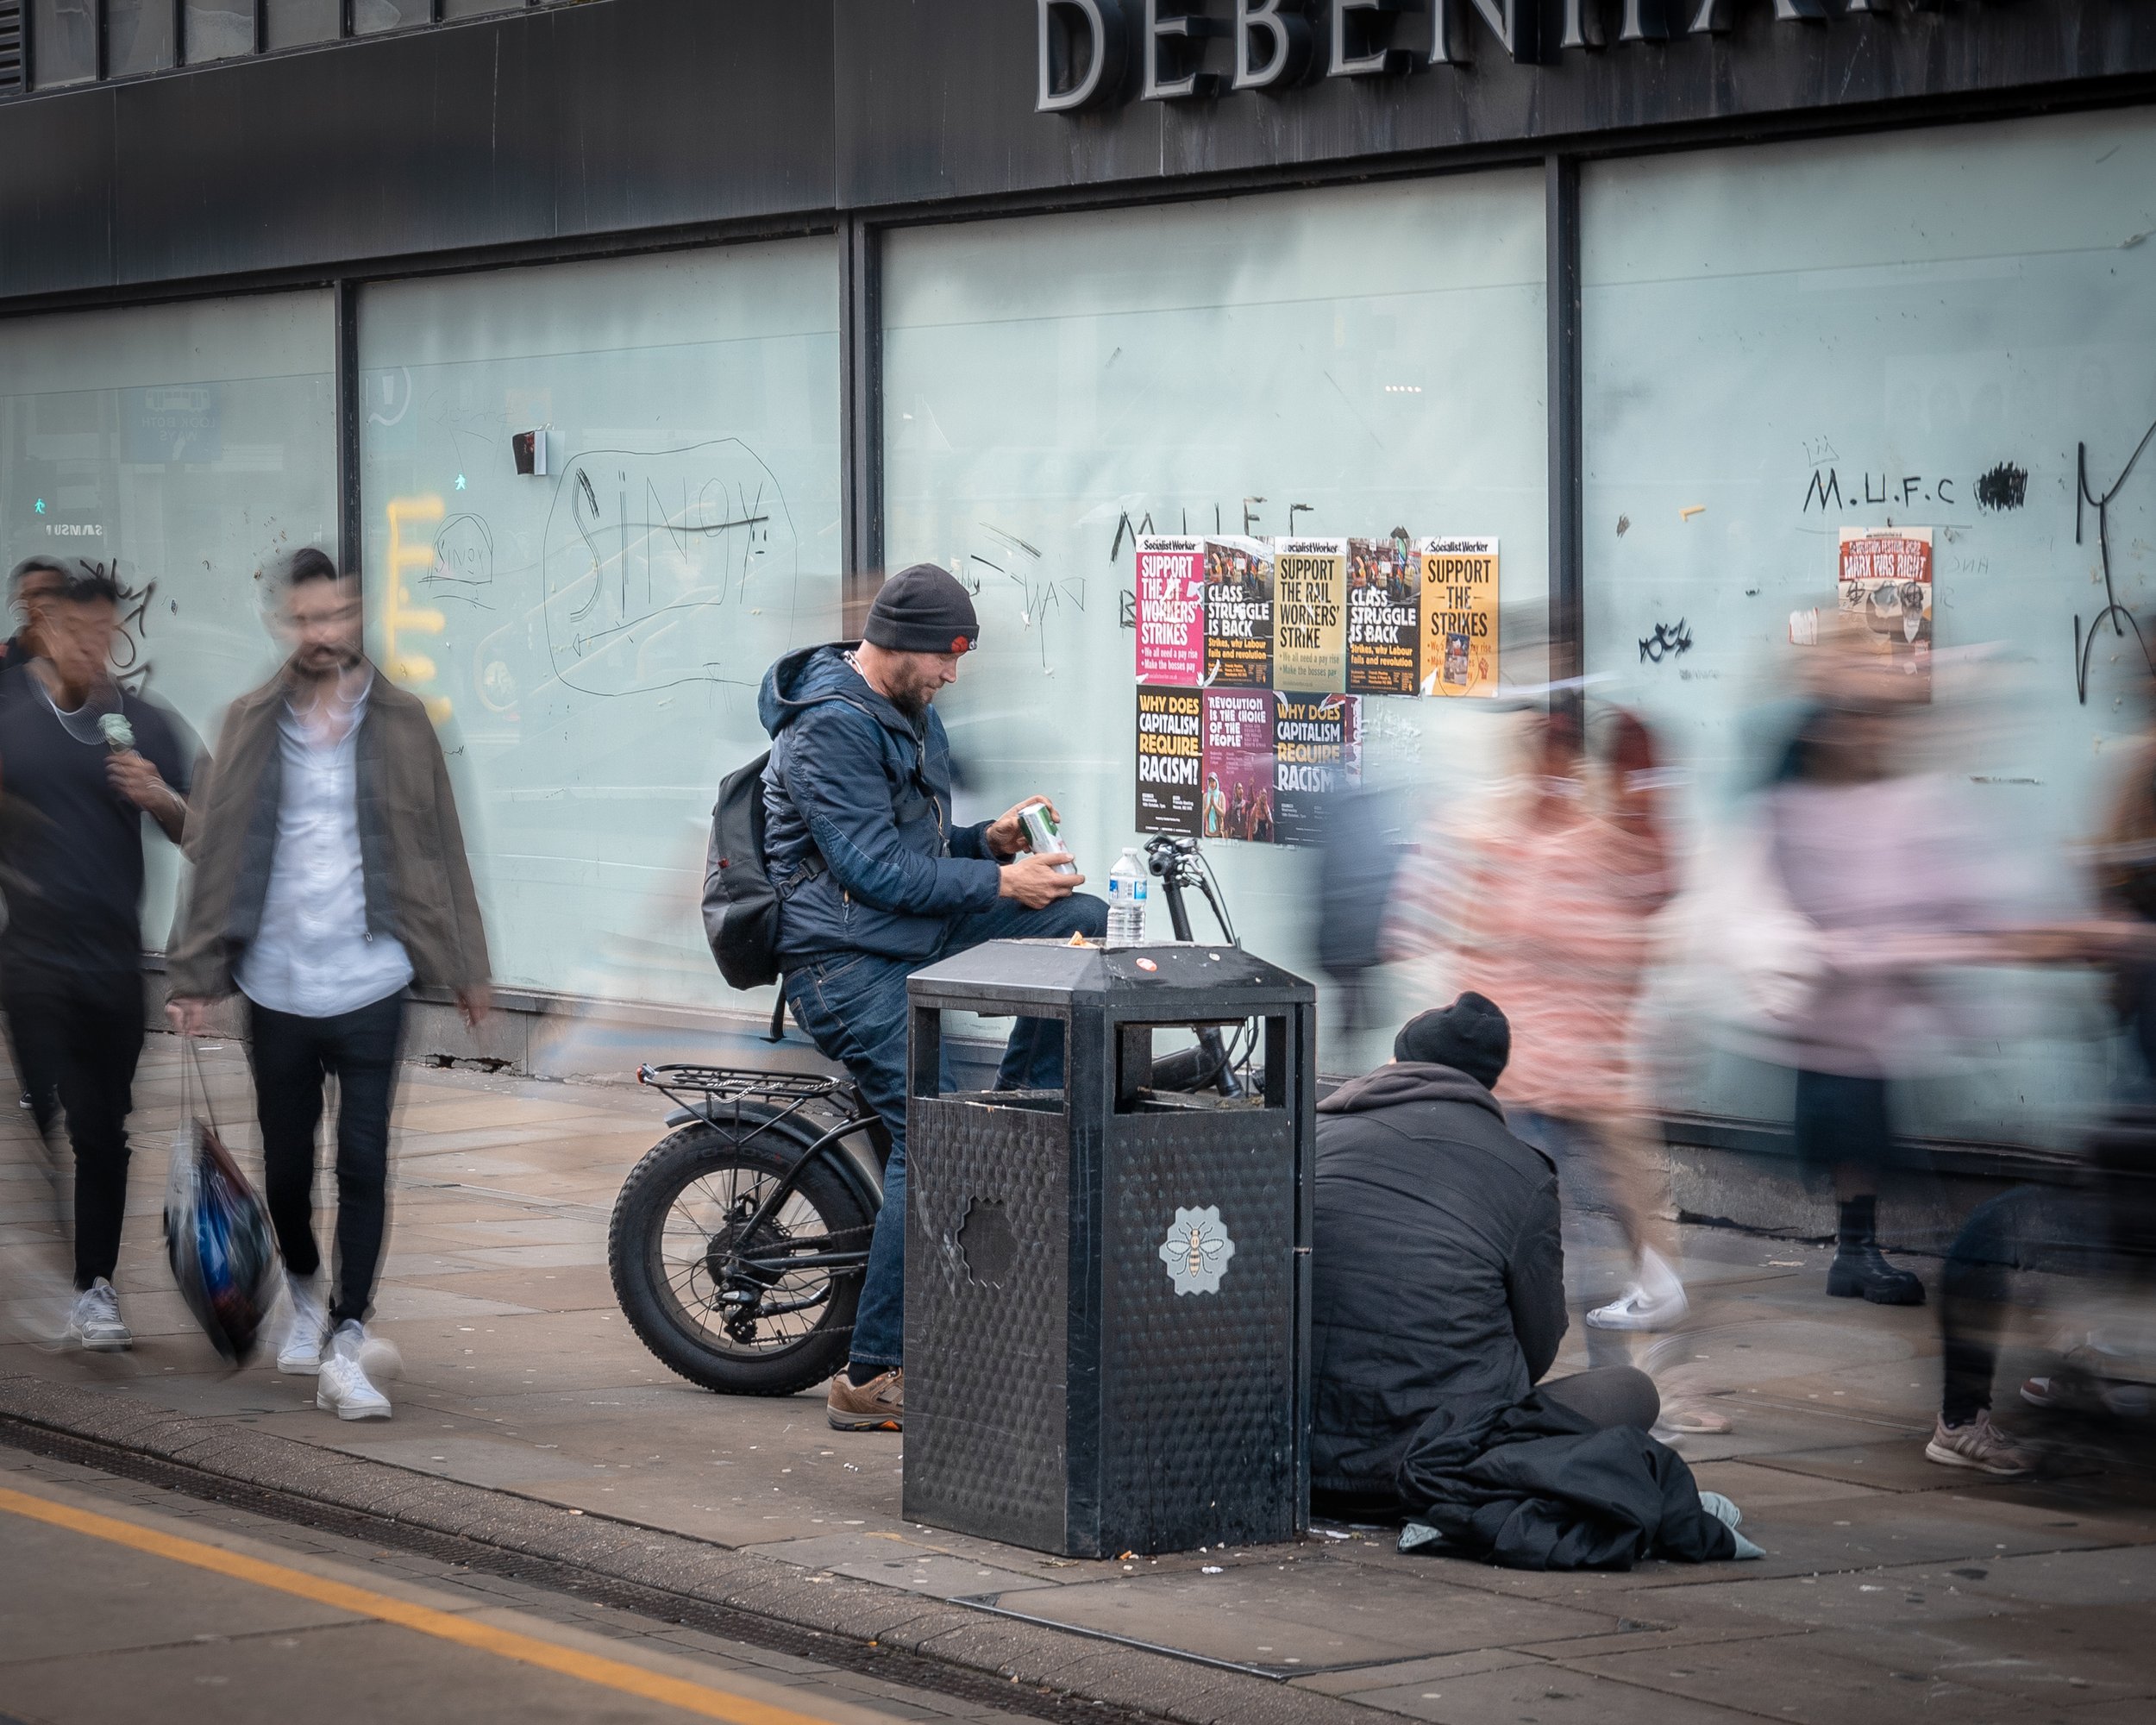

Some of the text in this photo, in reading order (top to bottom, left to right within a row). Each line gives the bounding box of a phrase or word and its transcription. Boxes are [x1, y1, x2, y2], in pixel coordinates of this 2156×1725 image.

[1035, 0, 1919, 113] DEBEN
[1462, 542, 1489, 553] Worker
[1141, 555, 1194, 579] SUPPORT
[1281, 558, 1335, 580] SUPPORT
[1427, 559, 1491, 583] SUPPORT
[1844, 554, 1927, 580] MARX WAS RIGHT
[1141, 577, 1163, 600] THE
[1208, 585, 1243, 602] CLASS
[1280, 581, 1332, 604] THE RAIL
[1351, 589, 1388, 606] CLASS
[1445, 586, 1472, 610] THE
[1208, 602, 1269, 621] STRUGGLE
[1281, 604, 1339, 627] WORKERS'
[1351, 607, 1417, 627] STRUGGLE
[1141, 622, 1188, 646] STRIKES
[1208, 619, 1253, 637] IS BACK
[1351, 624, 1399, 643] IS BACK
[1431, 612, 1489, 637] STRIKES
[1231, 638, 1243, 649] why
[1244, 638, 1267, 649] Labour
[1280, 625, 1321, 649] STRIKE
[1178, 649, 1187, 661] pay
[1188, 648, 1198, 659] rise
[1208, 648, 1267, 659] fails and revolution
[1375, 644, 1388, 655] why
[1388, 644, 1413, 656] Labour
[1158, 659, 1167, 670] the
[1168, 659, 1186, 671] bosses
[1186, 662, 1195, 673] pay
[1298, 665, 1307, 675] the
[1307, 666, 1326, 676] bosses
[1319, 656, 1328, 666] pay
[1351, 654, 1413, 667] fails and revolution
[1139, 694, 1200, 715] WHY DOES
[1277, 702, 1341, 721] WHY DOES
[1138, 712, 1200, 736] CAPITALISM
[1209, 709, 1266, 724] IS THE CHOICE
[1209, 721, 1241, 735] OF THE
[1276, 721, 1341, 743] CAPITALISM
[1138, 733, 1200, 756] REQUIRE
[1277, 742, 1340, 764] REQUIRE
[1138, 754, 1199, 786] RACISM?
